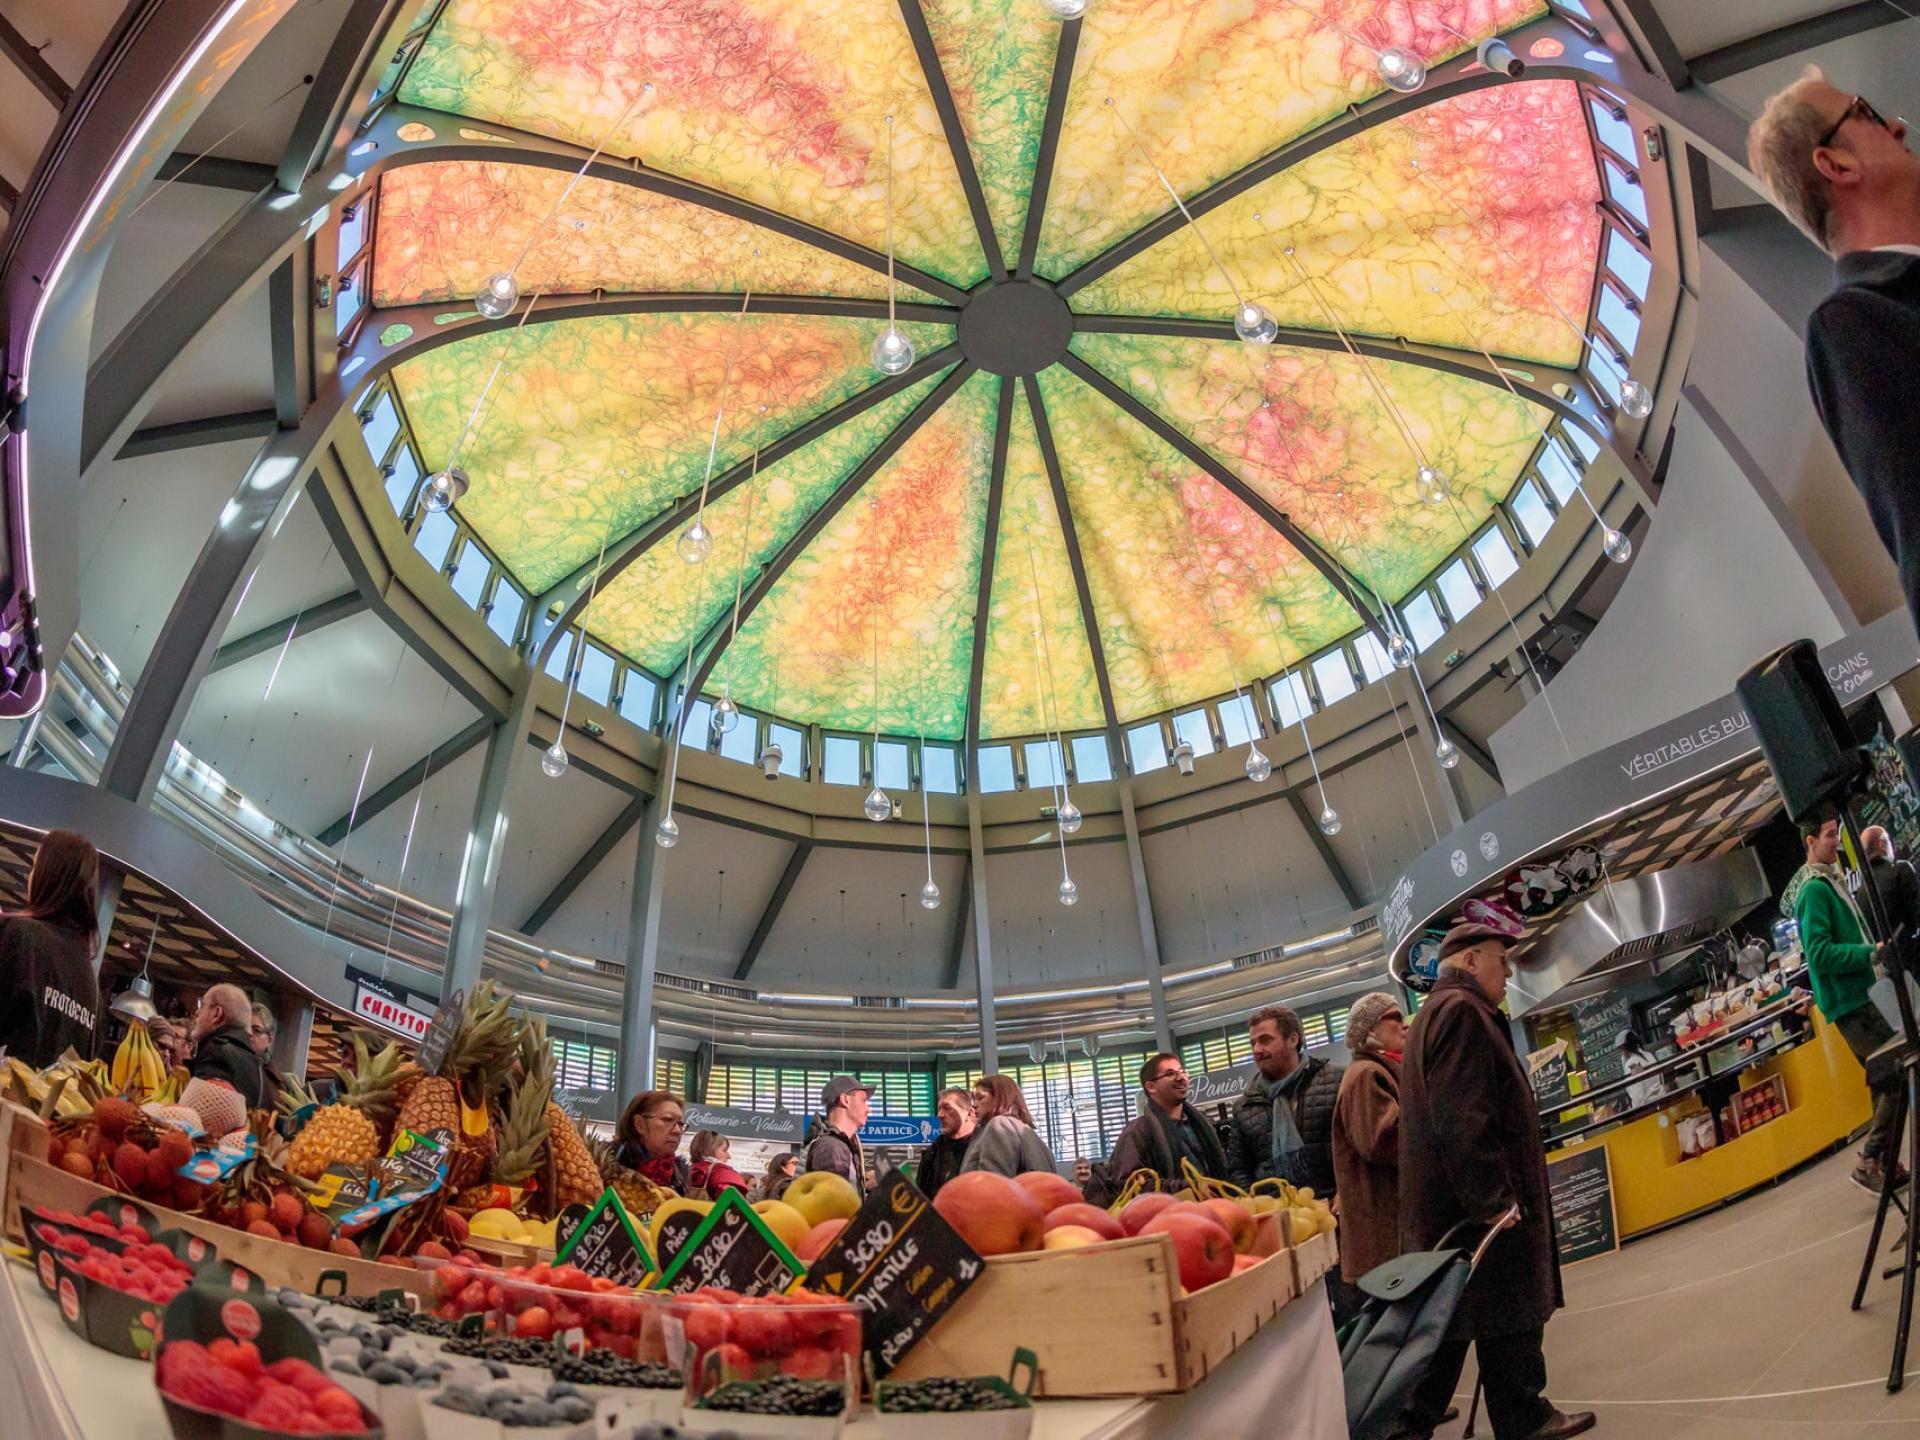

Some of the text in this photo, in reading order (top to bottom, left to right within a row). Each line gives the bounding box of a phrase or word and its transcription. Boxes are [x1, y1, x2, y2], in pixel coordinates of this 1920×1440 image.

[1620, 725, 1720, 777] VÉRITABLES
[750, 1115, 794, 1133] Volaille
[868, 1126, 913, 1135] PATRICE
[890, 1182, 919, 1214] €
[959, 1259, 979, 1280] 1
